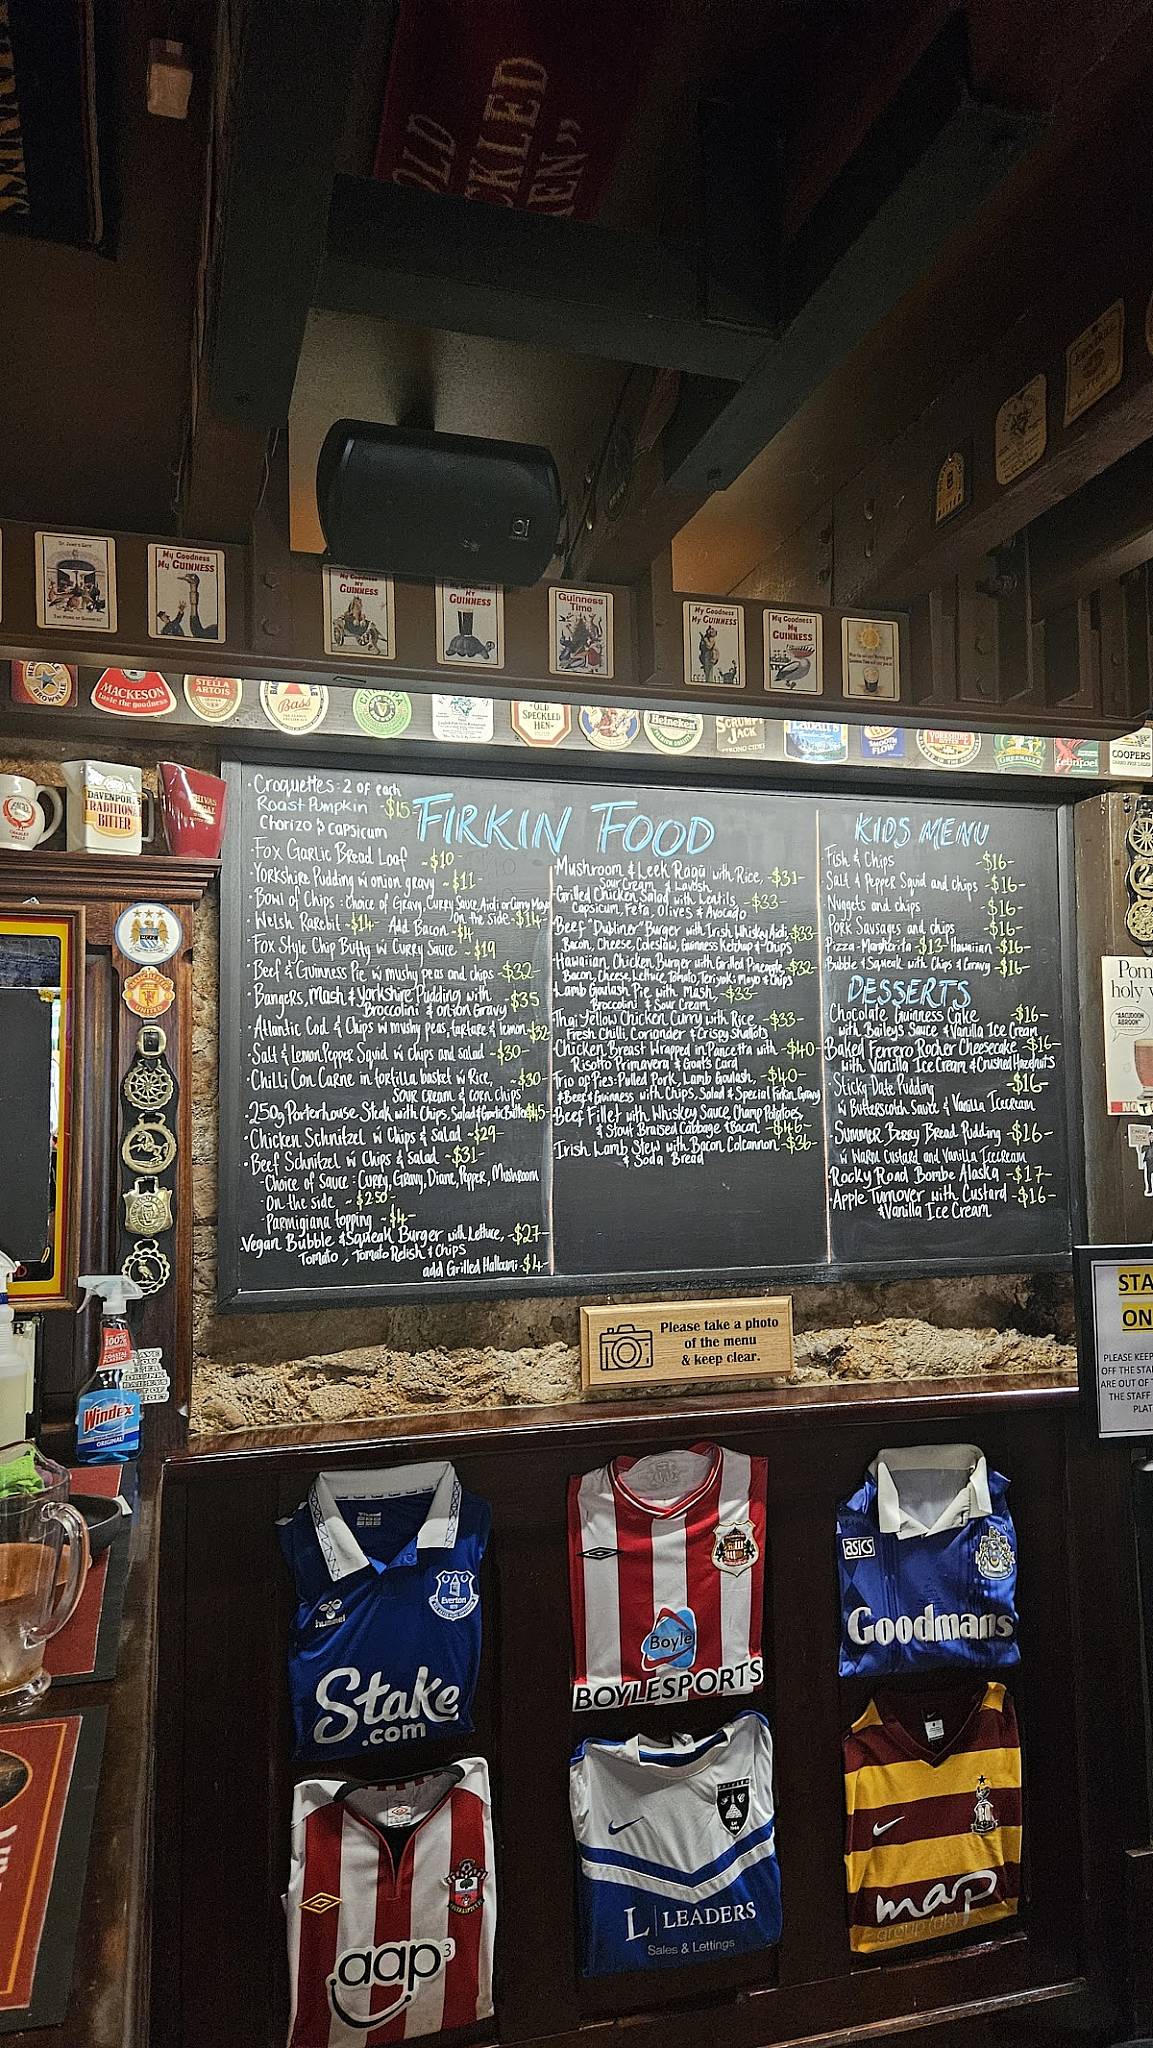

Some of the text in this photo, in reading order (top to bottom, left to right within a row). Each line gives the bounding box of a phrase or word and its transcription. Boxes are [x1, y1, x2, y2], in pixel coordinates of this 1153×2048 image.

[176, 552, 209, 561] Goodness
[172, 560, 214, 572] GUINNESS
[339, 584, 378, 596] GUINNESS
[449, 593, 491, 606] GUINNESS
[558, 592, 603, 606] Guinness
[570, 601, 592, 613] Time
[703, 616, 737, 625] GUINNESS
[773, 631, 812, 640] GUINNESS
[101, 683, 166, 700] MACKESON
[195, 686, 231, 695] ARTOIS
[196, 679, 229, 688] STELLA
[33, 688, 62, 703] BROWN
[132, 699, 168, 709] goodness
[278, 698, 311, 712] Bass
[523, 710, 561, 721] SPECKLED
[651, 714, 696, 730] Heineken
[728, 727, 757, 744] JACK
[868, 737, 897, 746] SMOOTH
[872, 744, 895, 755] FLOW
[1112, 750, 1151, 760] COOPERS
[88, 790, 141, 805] DAVENPORS
[85, 800, 138, 816] TRADITION
[98, 816, 131, 830] BITTER
[413, 793, 572, 856] FIRKIN
[854, 812, 990, 850] KIDS MENU
[825, 843, 851, 868] Fish
[864, 850, 895, 875] Chips
[556, 855, 626, 876] Mushroom
[637, 862, 668, 880] Leek
[713, 865, 734, 881] with
[827, 896, 921, 921] Nuggets and chips
[253, 960, 280, 982] Beef
[385, 968, 418, 989] mushy
[422, 967, 444, 987] peas
[448, 966, 467, 981] and
[470, 964, 495, 986] chips
[554, 983, 678, 1000] Lamb Goulash Pie with
[848, 975, 972, 1009] DESSERTS
[1111, 980, 1143, 998] holy
[135, 1005, 163, 1014] UNITED
[829, 1003, 980, 1025] Chocolate Guinness Cake
[554, 1010, 729, 1032] Thai Yellow Chicken Curry with
[825, 1037, 1018, 1061] Baked Ferrero Rocher Cheesecake
[249, 1102, 285, 1128] 250g
[284, 1100, 359, 1124] Porterhouse
[361, 1100, 394, 1127] Steak
[555, 1139, 591, 1159] Irish
[594, 1139, 628, 1156] Lamb
[633, 1139, 661, 1155] Stew
[665, 1138, 688, 1153] with
[689, 1137, 726, 1153] Bacon
[726, 1136, 780, 1151] Colcannon
[634, 1153, 664, 1168] Soda
[671, 1151, 704, 1166] Bread
[830, 1166, 872, 1189] Rocky
[874, 1167, 909, 1186] Road
[914, 1166, 956, 1183] Bombe
[959, 1164, 1000, 1183] Alaska
[832, 1183, 1007, 1212] Apple Turnover with Custard
[660, 1317, 778, 1333] Please take a photo
[106, 1335, 126, 1346] 100%
[685, 1335, 757, 1349] of the menu
[681, 1351, 761, 1366] & keep clear.
[1104, 1353, 1132, 1361] PLEASE
[1101, 1367, 1116, 1375] OFF
[1119, 1366, 1134, 1374] THE
[1101, 1380, 1116, 1388] ARE
[1119, 1379, 1136, 1387] OUT
[1109, 1392, 1150, 1400] THE STAFF
[84, 1405, 135, 1434] Windex
[96, 1436, 124, 1447] ORIGINAL
[845, 1540, 872, 1557] asics
[441, 1596, 466, 1604] Everton
[315, 1615, 345, 1628] hummel
[848, 1604, 1014, 1646] Goodmans
[650, 1631, 692, 1652] Boyle
[575, 1659, 762, 1710] BOYLESPORTS
[314, 1666, 460, 1744] Stake
[362, 1722, 426, 1746] .com
[876, 1869, 998, 1923] map
[624, 1901, 756, 1941] L LEADERS
[648, 1939, 735, 1956] Sales & Lettings
